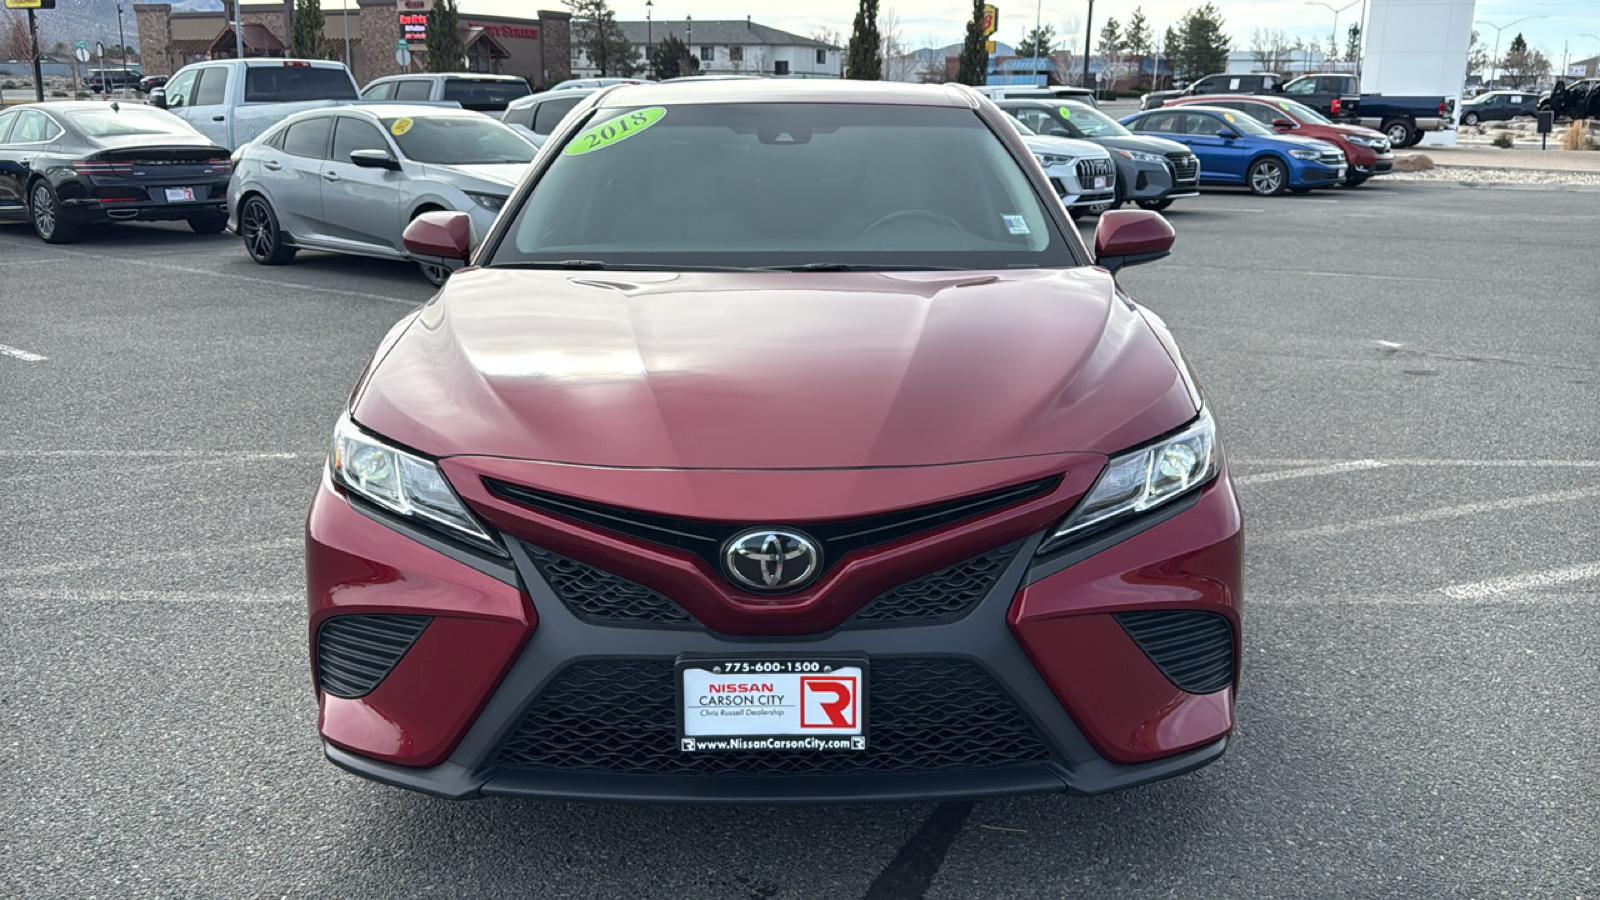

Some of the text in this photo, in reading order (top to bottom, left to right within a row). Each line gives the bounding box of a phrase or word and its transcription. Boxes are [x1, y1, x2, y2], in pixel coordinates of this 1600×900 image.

[583, 112, 647, 149] 2018
[724, 662, 820, 672] 775-600-1500
[709, 683, 774, 693] NISSAN
[699, 695, 785, 706] CARSON CITY
[700, 709, 719, 717] Chris
[745, 709, 785, 717] Dealership
[697, 737, 850, 751] www.NissanCarsonCity.com
